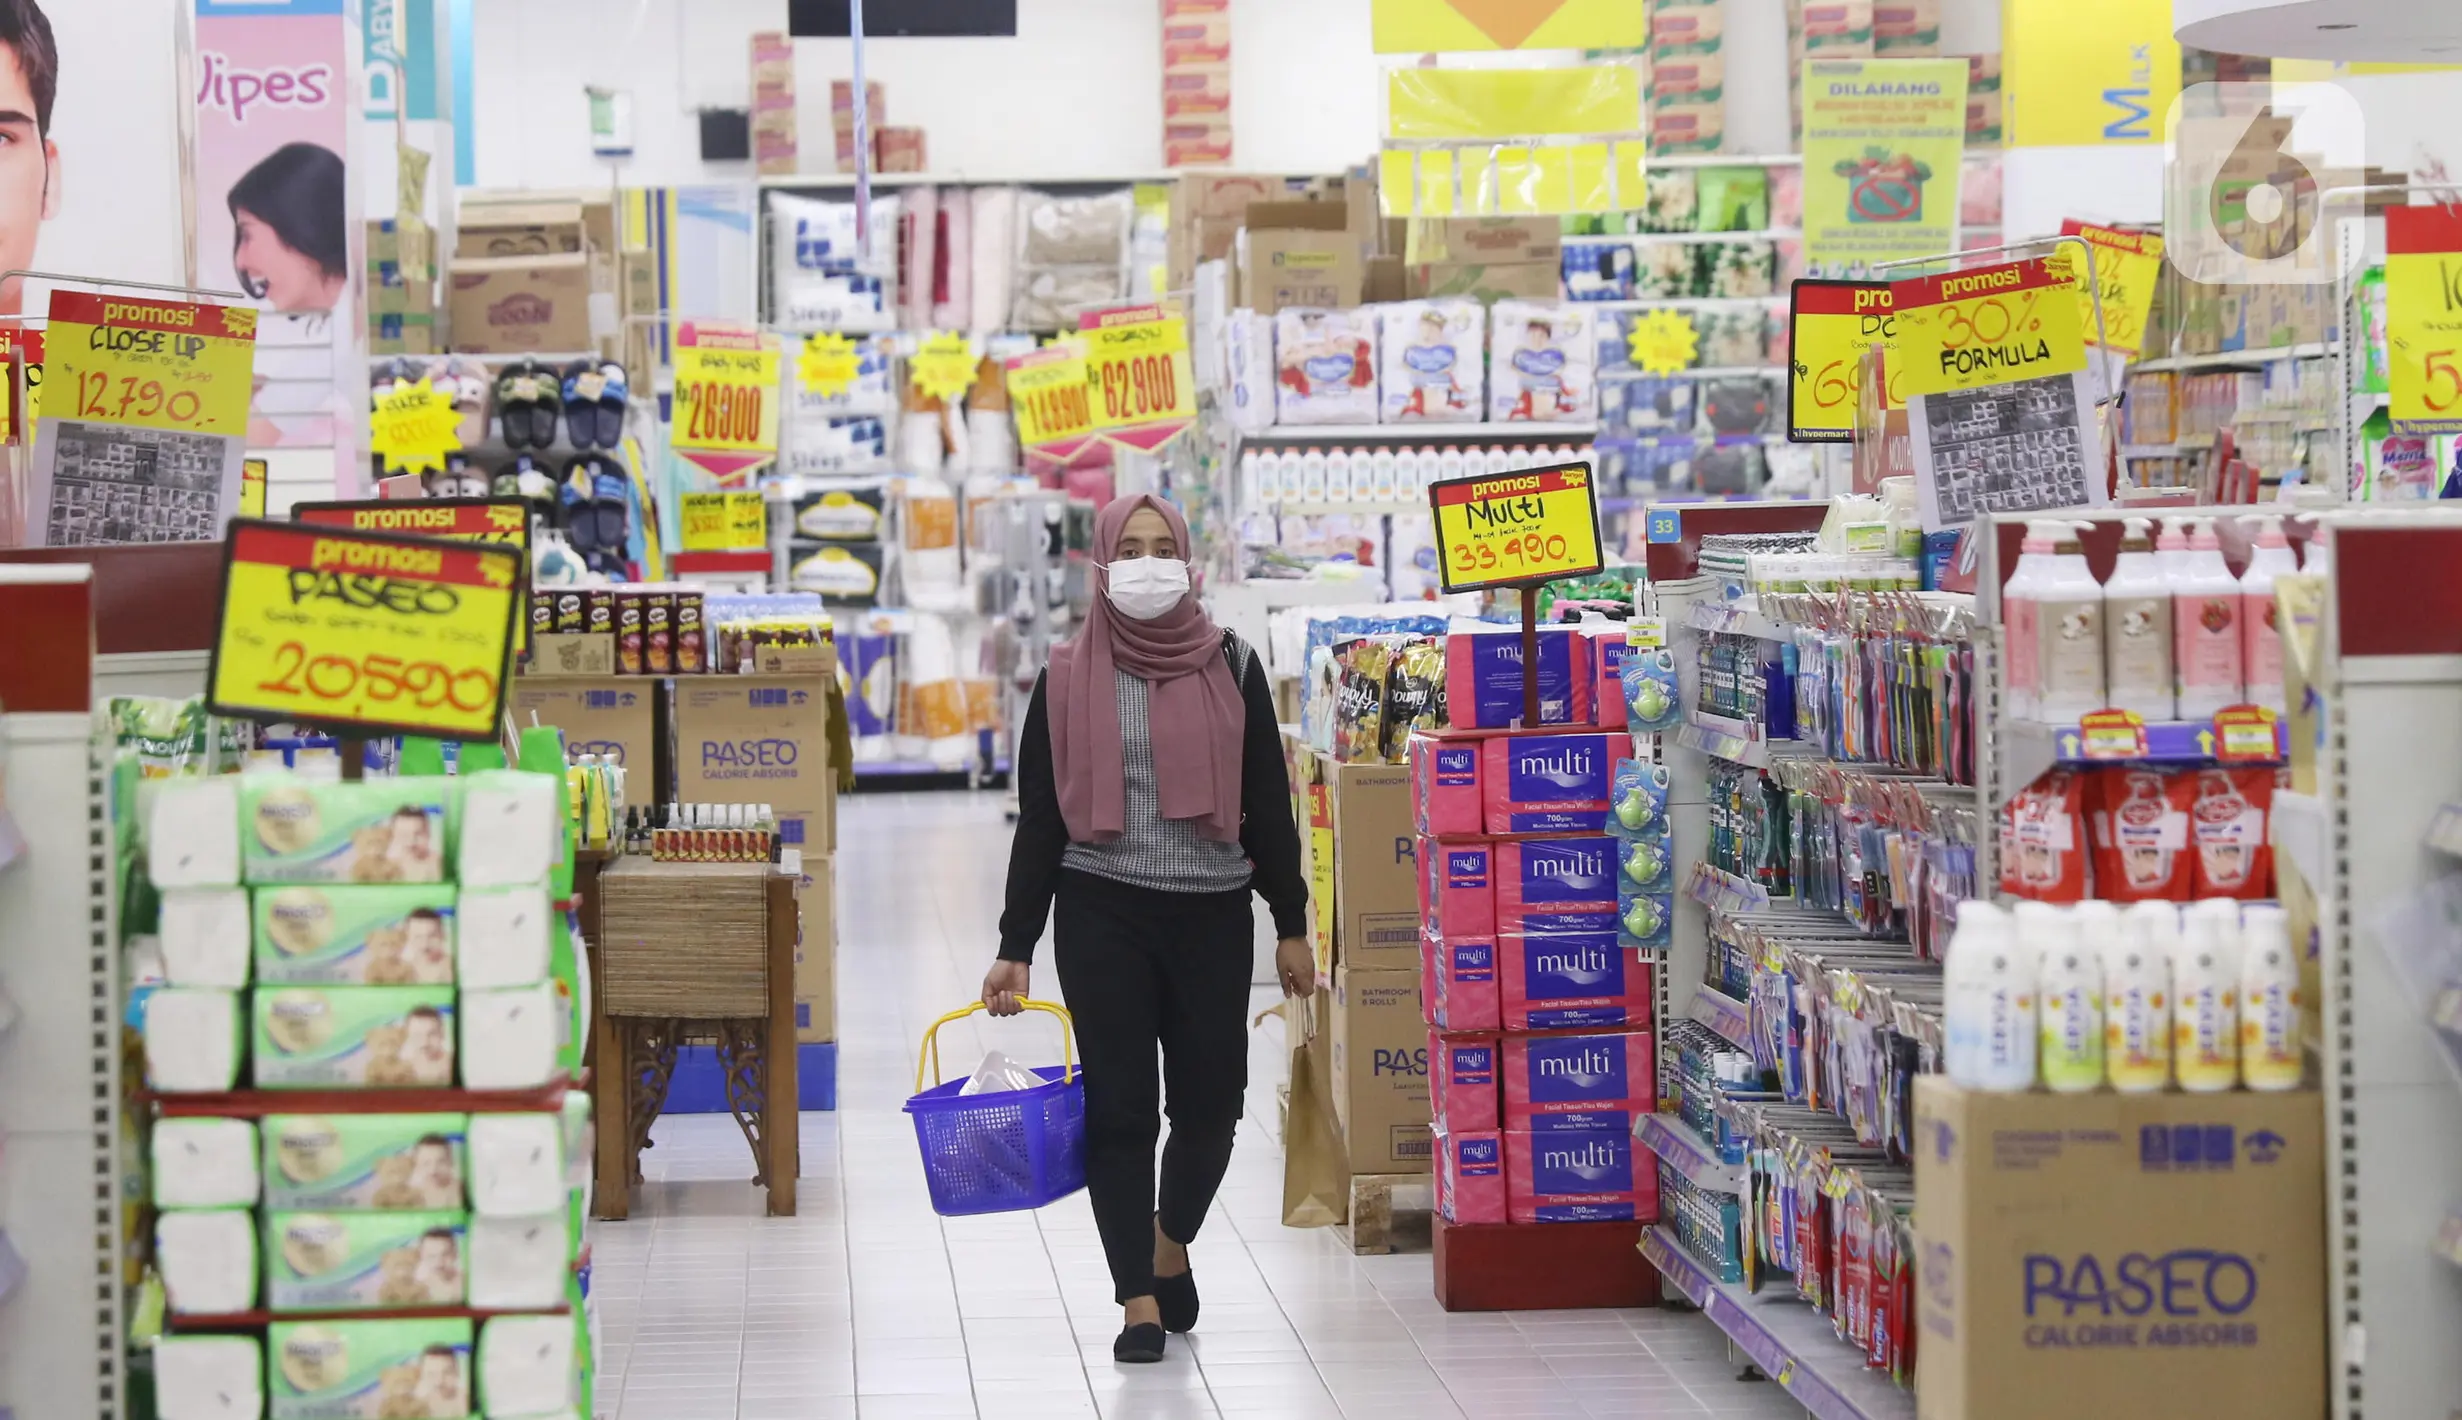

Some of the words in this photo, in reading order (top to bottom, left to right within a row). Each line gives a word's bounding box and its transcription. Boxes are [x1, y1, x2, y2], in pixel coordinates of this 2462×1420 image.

[1941, 264, 2021, 300] promosi
[1854, 290, 1893, 312] pro
[104, 303, 196, 327] promosi
[1938, 291, 2041, 349] 30%
[90, 326, 165, 353] CLOSE
[174, 333, 206, 360] UP
[1940, 338, 2050, 375] FORMULA
[1102, 353, 1176, 418] 62900
[1803, 431, 1849, 439] hypermart
[1472, 475, 1541, 500] promosi
[354, 508, 456, 529] promosi
[1465, 491, 1545, 530] Multi
[1655, 519, 1674, 534] 33
[312, 538, 443, 574] promosi
[288, 569, 461, 615] PASEO
[1497, 640, 1543, 658] mui
[702, 738, 798, 768] PASEO
[1440, 752, 1468, 765] multi
[1521, 748, 1592, 775] multi
[703, 769, 749, 780] CALORIE
[753, 769, 798, 779] ABSORB
[1453, 855, 1480, 867] multi
[1533, 850, 1603, 877] multi
[1458, 948, 1486, 961] multi
[1537, 945, 1607, 972] multi
[1361, 988, 1411, 997] BATHROOM
[1374, 1048, 1428, 1076] PAS
[1457, 1051, 1485, 1063] multi
[1540, 1048, 1610, 1076] multi
[1463, 1143, 1491, 1155] multi
[1544, 1140, 1614, 1168] multi
[2023, 1248, 2258, 1317] PASEO
[2024, 1323, 2139, 1347] CALORIE
[2147, 1323, 2258, 1347] ABSORB
